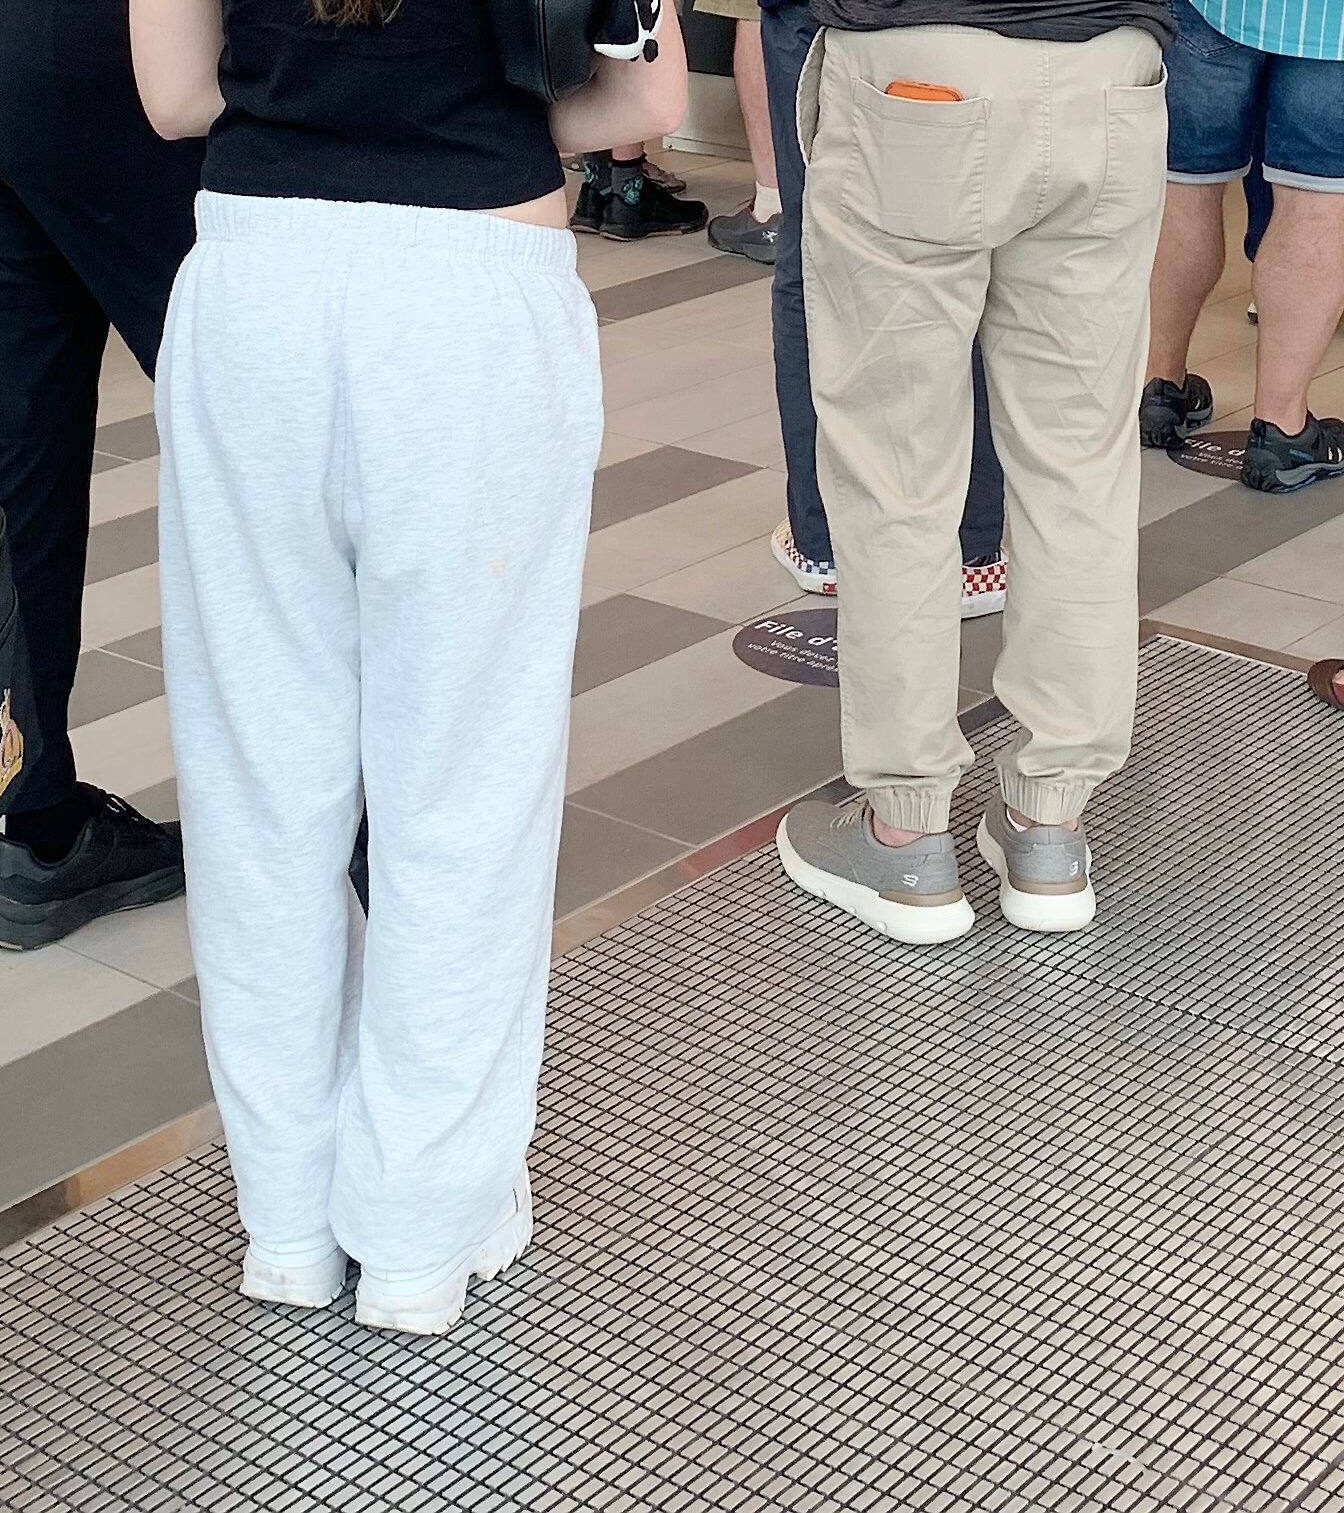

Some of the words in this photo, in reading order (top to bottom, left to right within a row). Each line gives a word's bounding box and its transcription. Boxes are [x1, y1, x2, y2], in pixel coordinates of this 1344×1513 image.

[754, 620, 804, 640] File
[747, 643, 778, 655] votre
[780, 651, 806, 663] titre
